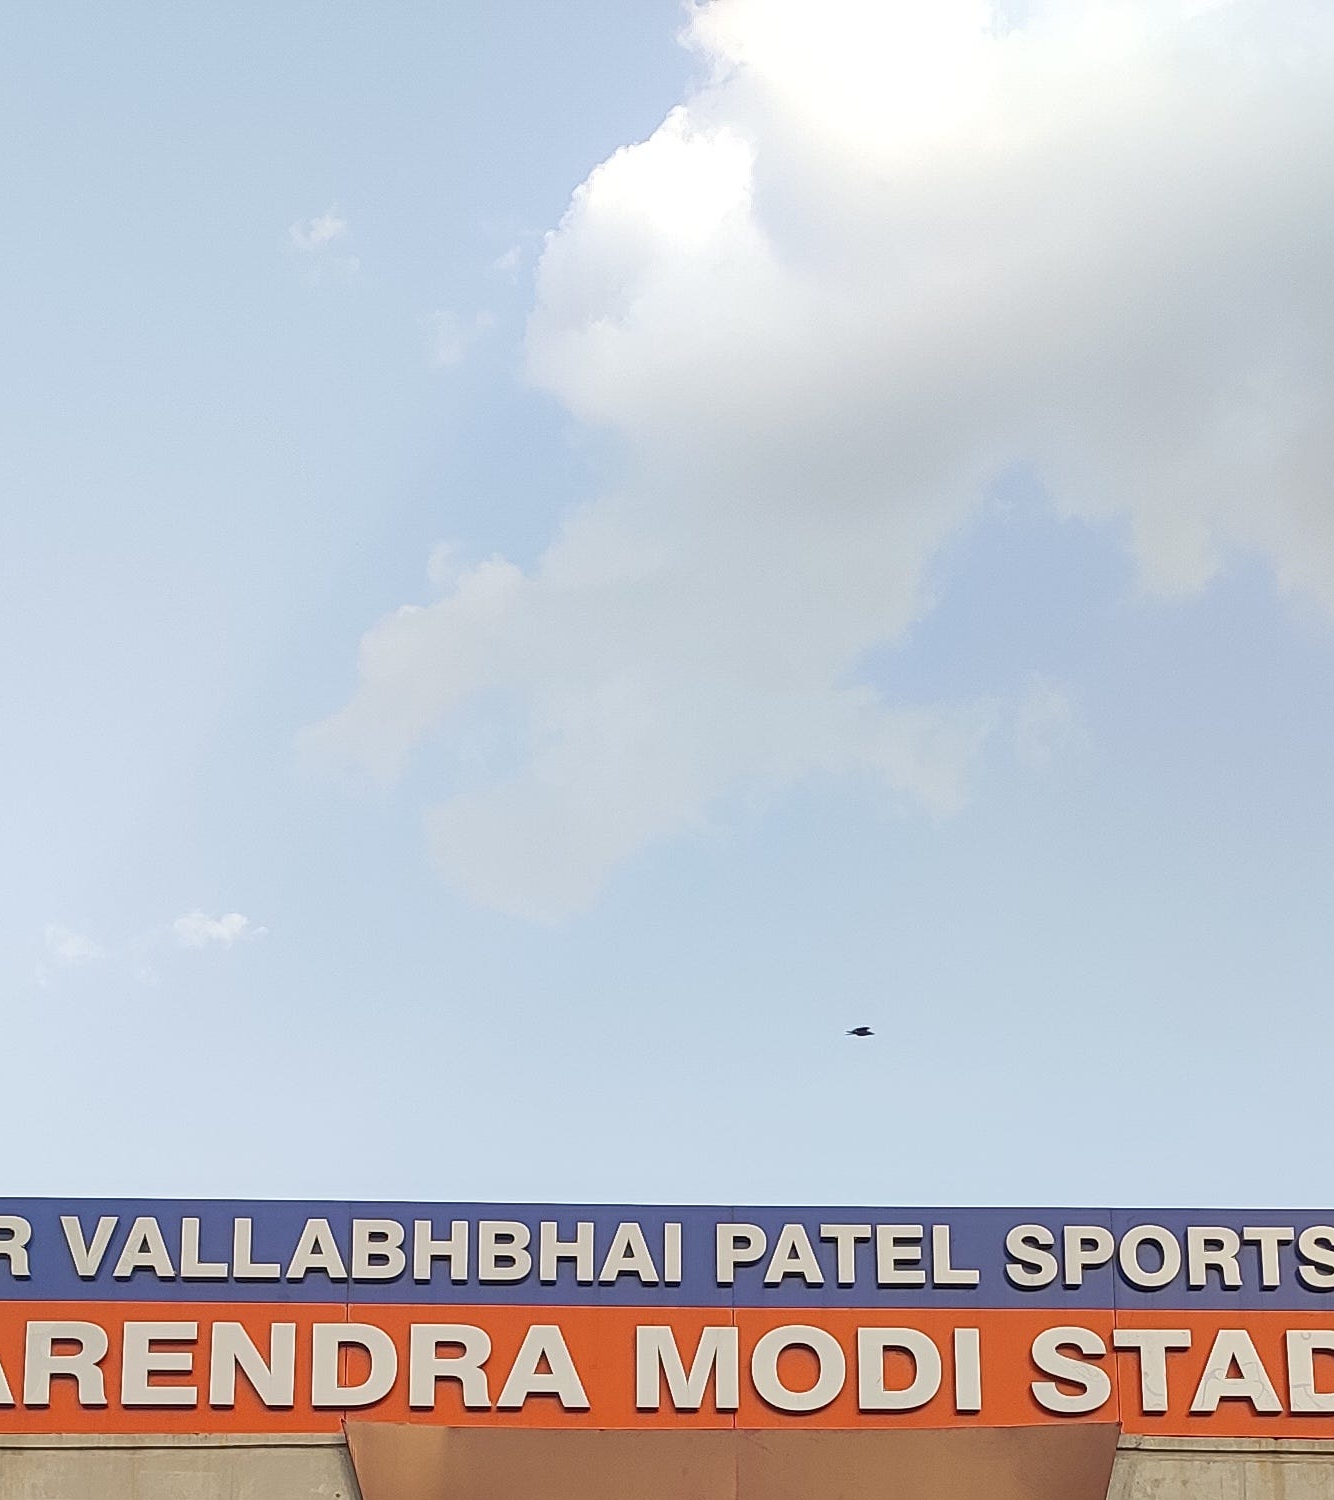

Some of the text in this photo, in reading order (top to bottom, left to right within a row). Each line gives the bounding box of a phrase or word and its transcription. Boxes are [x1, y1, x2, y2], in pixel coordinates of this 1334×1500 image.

[59, 1215, 684, 1284] VALLABHBHAI
[715, 1223, 981, 1286] PATEL
[634, 1324, 984, 1412] MODI
